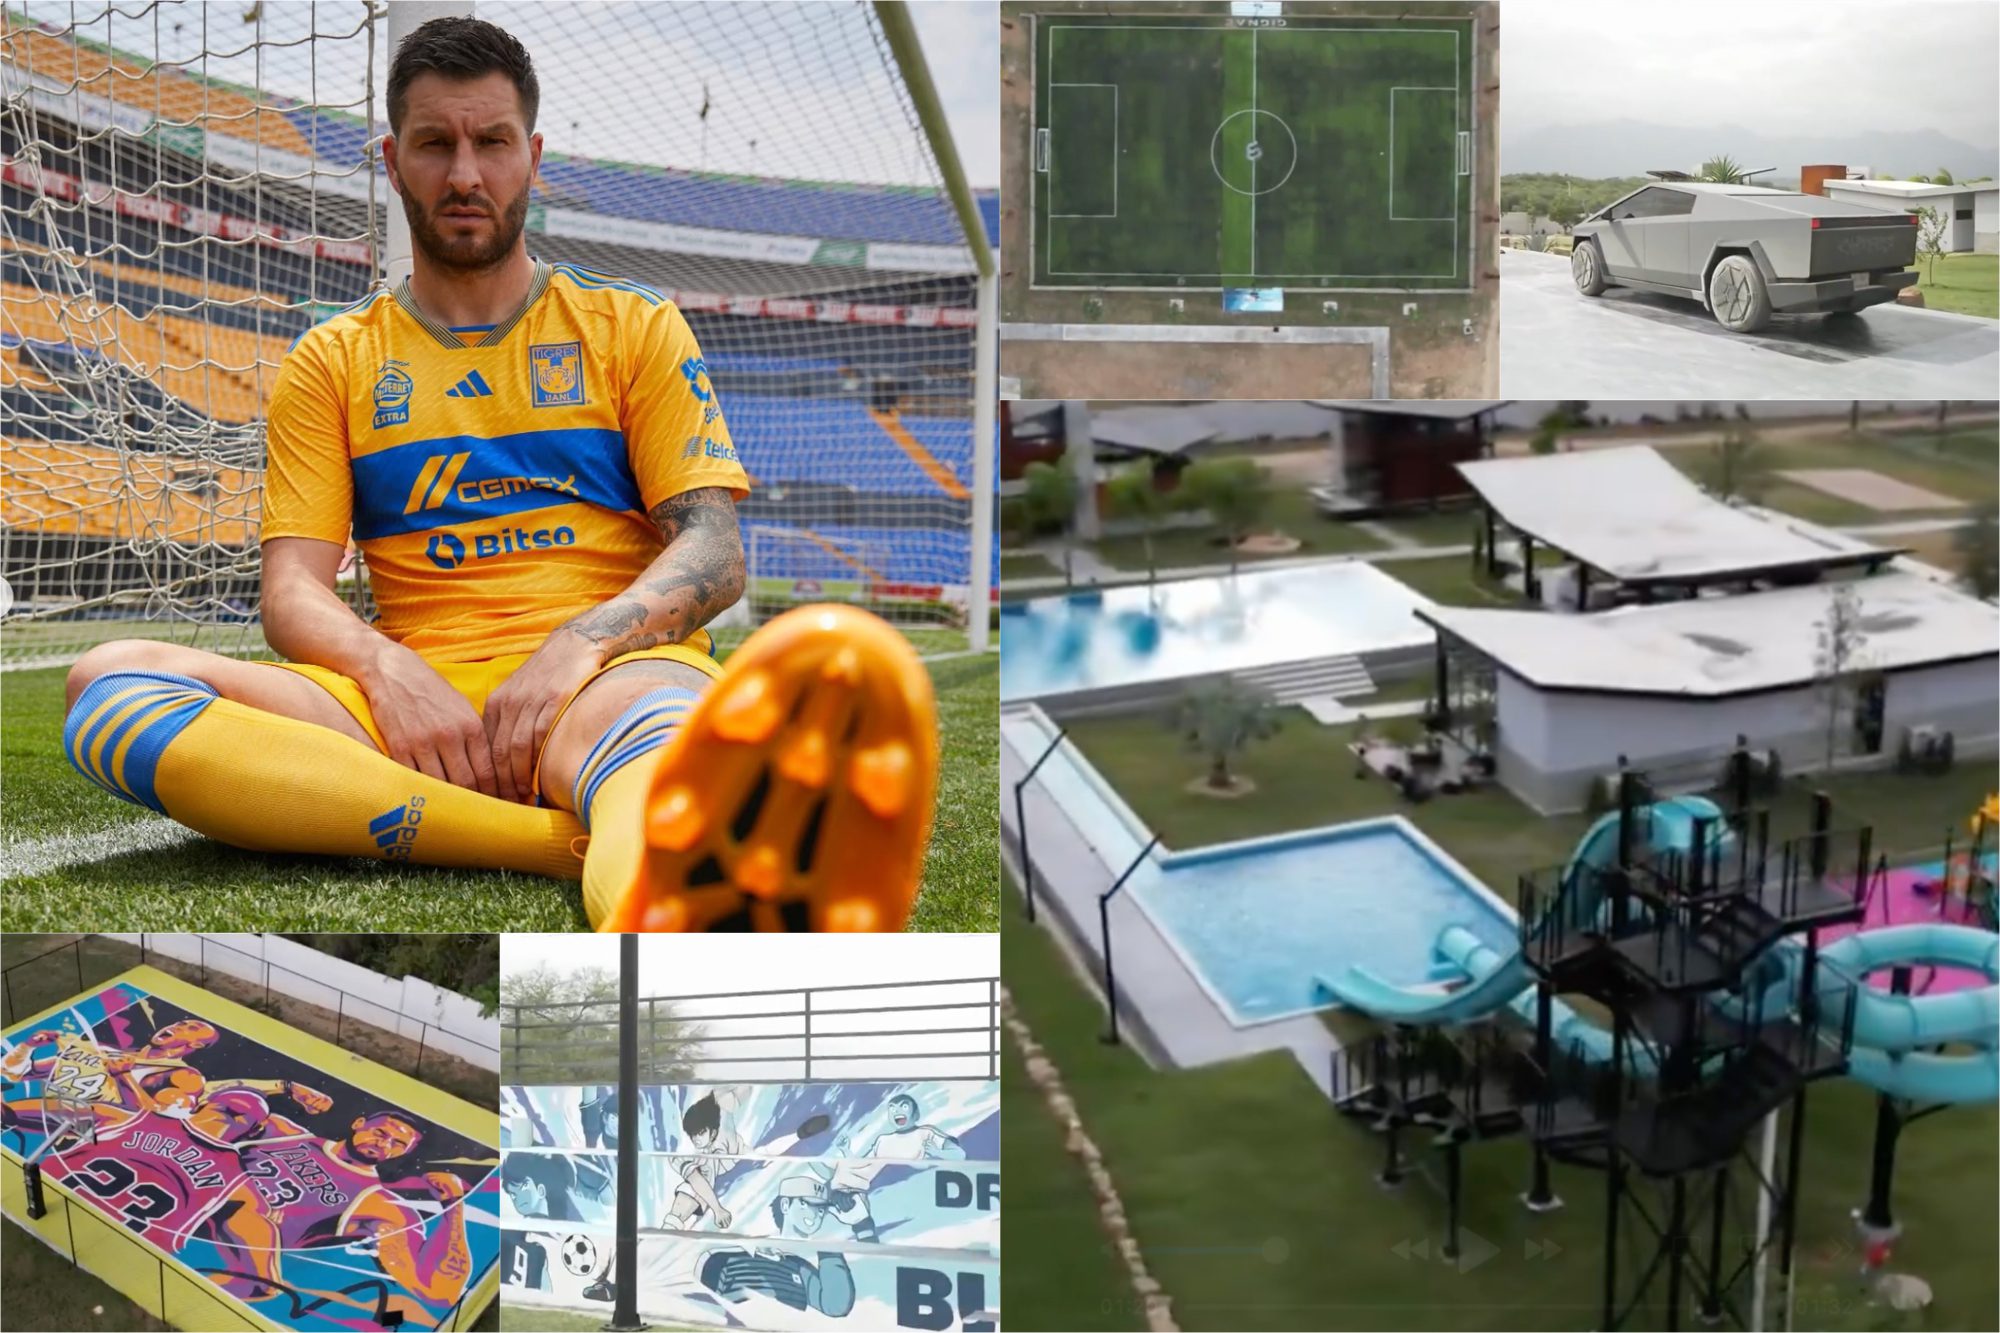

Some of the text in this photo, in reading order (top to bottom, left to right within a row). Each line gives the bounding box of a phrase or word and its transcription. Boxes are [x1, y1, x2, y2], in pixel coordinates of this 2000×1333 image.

[535, 346, 577, 359] TIGRES
[545, 392, 572, 402] UANL
[374, 411, 407, 426] EXTRA
[475, 525, 576, 559] Bitso
[396, 794, 426, 866] didas
[46, 1065, 108, 1101] 24
[122, 1131, 226, 1190] JORDAN
[257, 1143, 349, 1206] LAKERS
[59, 1157, 178, 1234] 23
[935, 1170, 999, 1211] DR
